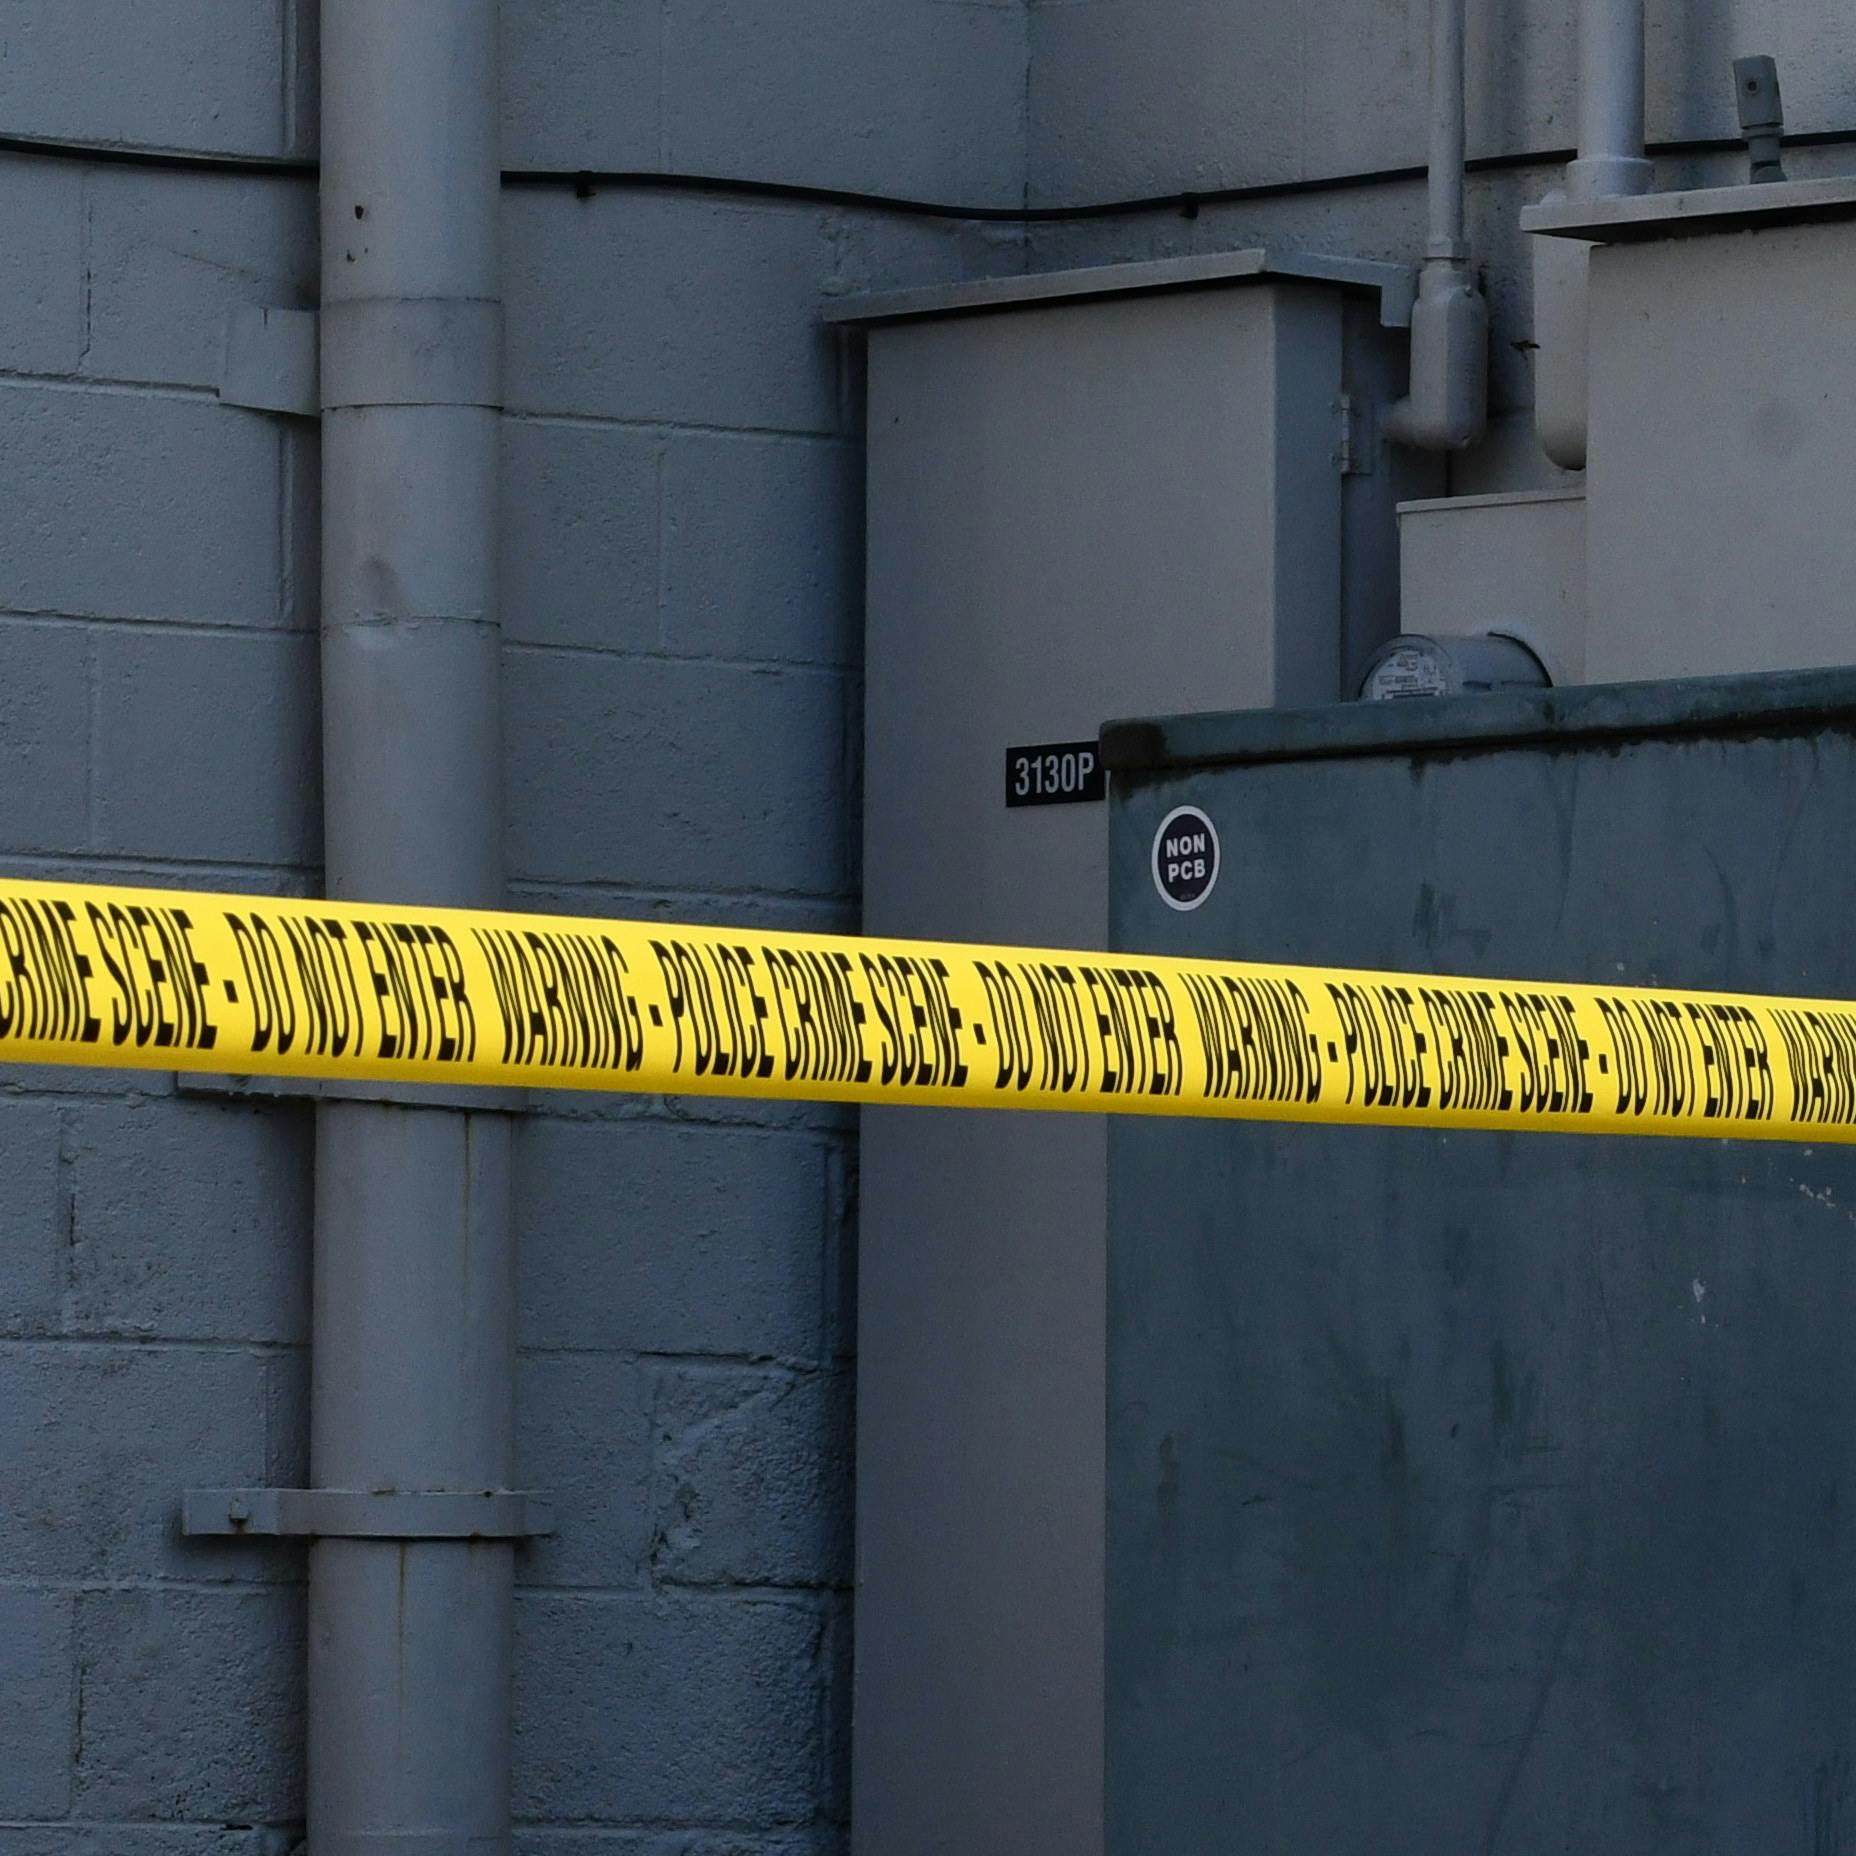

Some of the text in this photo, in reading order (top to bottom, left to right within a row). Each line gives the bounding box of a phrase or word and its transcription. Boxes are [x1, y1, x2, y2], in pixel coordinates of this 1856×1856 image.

[1015, 752, 1094, 796] 3130P
[1166, 833, 1206, 858] NON
[1168, 859, 1206, 883] PCB
[84, 901, 217, 1049] SCENE
[223, 912, 295, 1055] DO
[279, 916, 363, 1058] NOT
[351, 921, 475, 1062] ENTER
[472, 929, 643, 1072] WARNING
[649, 940, 774, 1079] POLICE
[761, 946, 872, 1083] CRIME
[859, 952, 968, 1087] SCENE
[973, 961, 1033, 1091] DO
[1018, 963, 1089, 1093] NOT
[1078, 966, 1182, 1096] ENTER
[1178, 973, 1321, 1104] WARNING
[1324, 983, 1431, 1109] POLICE
[1419, 988, 1512, 1111] CRIME
[1500, 992, 1593, 1114] SCENE
[1594, 998, 1647, 1116] DO
[1633, 1000, 1695, 1117] NOT
[1683, 1003, 1773, 1120] ENTER
